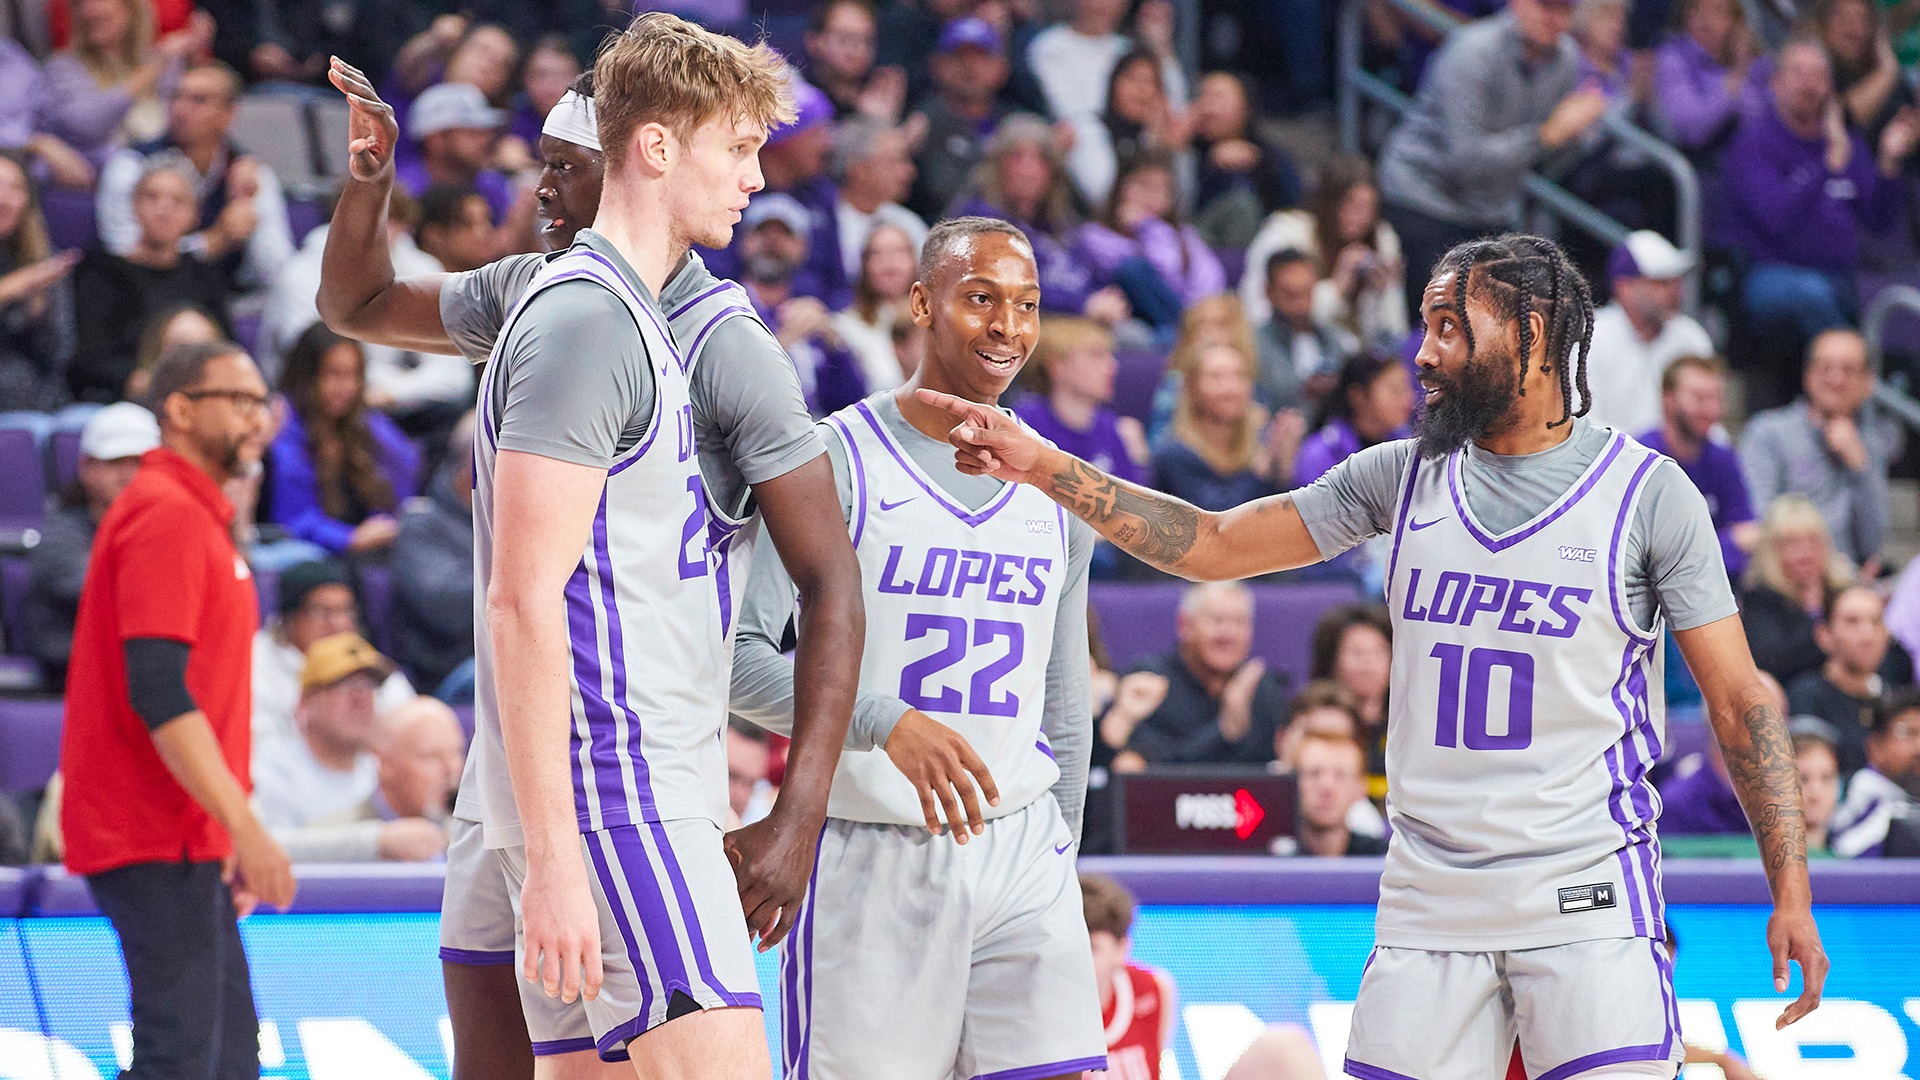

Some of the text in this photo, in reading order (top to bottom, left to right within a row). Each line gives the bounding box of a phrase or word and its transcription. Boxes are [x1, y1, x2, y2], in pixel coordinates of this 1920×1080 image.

[1026, 520, 1054, 534] WAC
[1558, 546, 1597, 562] WAC
[878, 545, 1053, 606] LOPES
[1403, 568, 1594, 639] LOPES
[899, 613, 1025, 718] 22
[1429, 642, 1535, 751] 10
[1597, 890, 1609, 902] M
